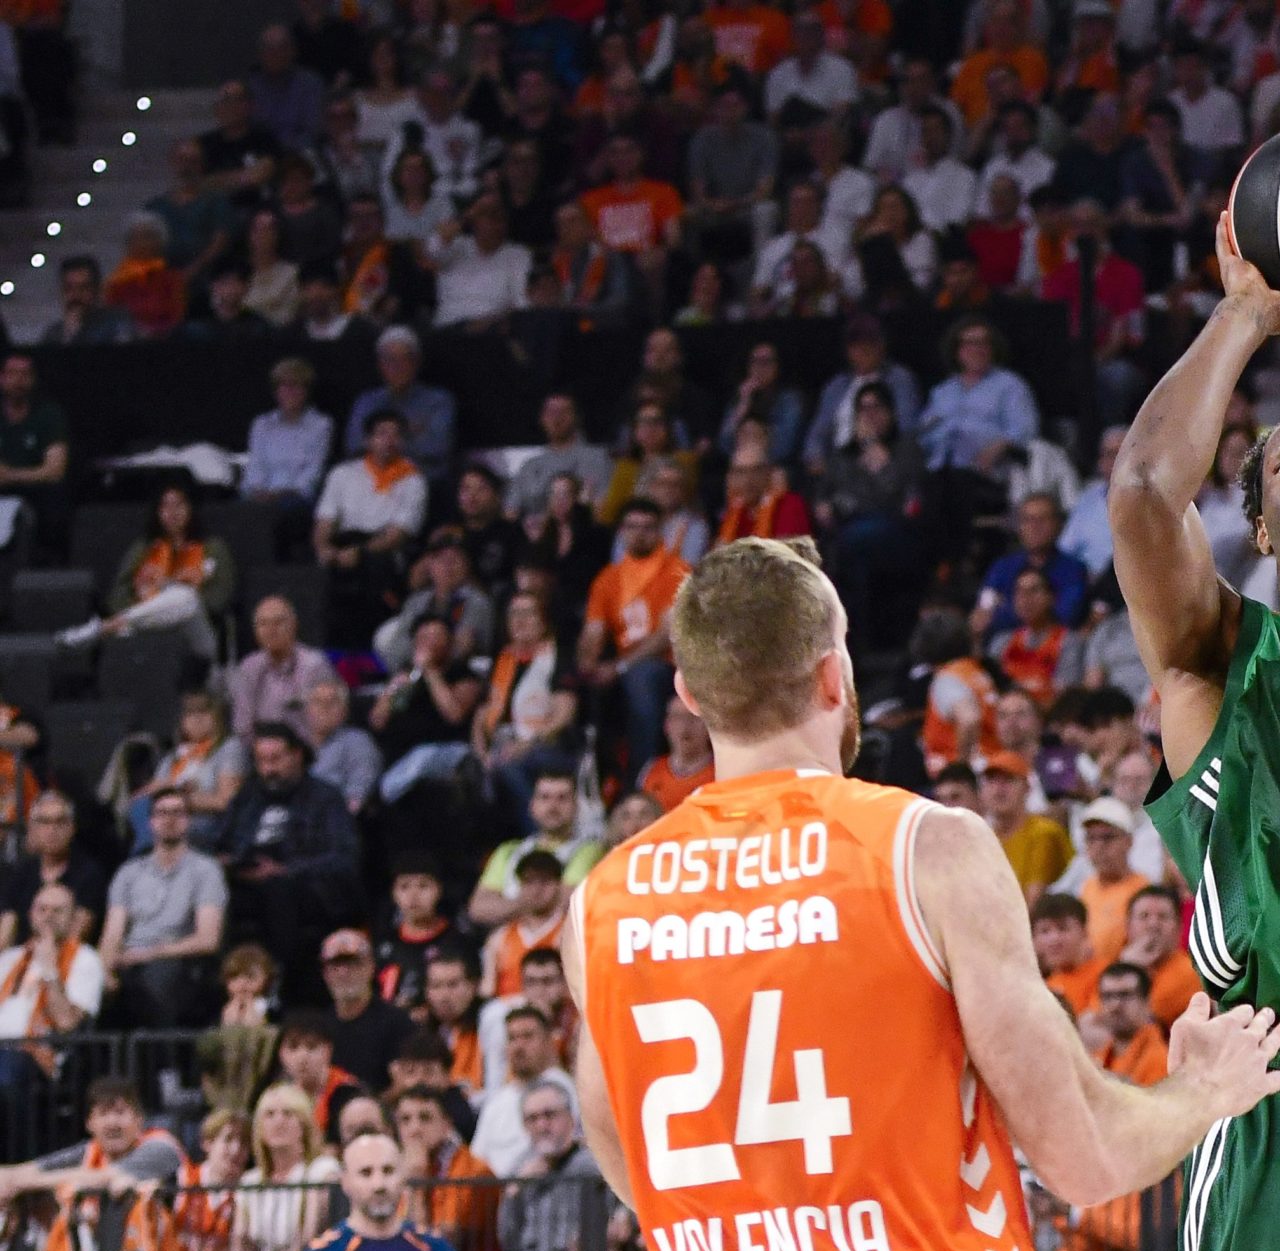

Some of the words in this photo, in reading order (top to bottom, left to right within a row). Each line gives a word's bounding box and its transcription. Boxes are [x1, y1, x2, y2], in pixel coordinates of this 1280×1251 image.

[627, 821, 828, 895] COSTELLO
[617, 895, 839, 964] PAMESA
[631, 989, 852, 1191] 24
